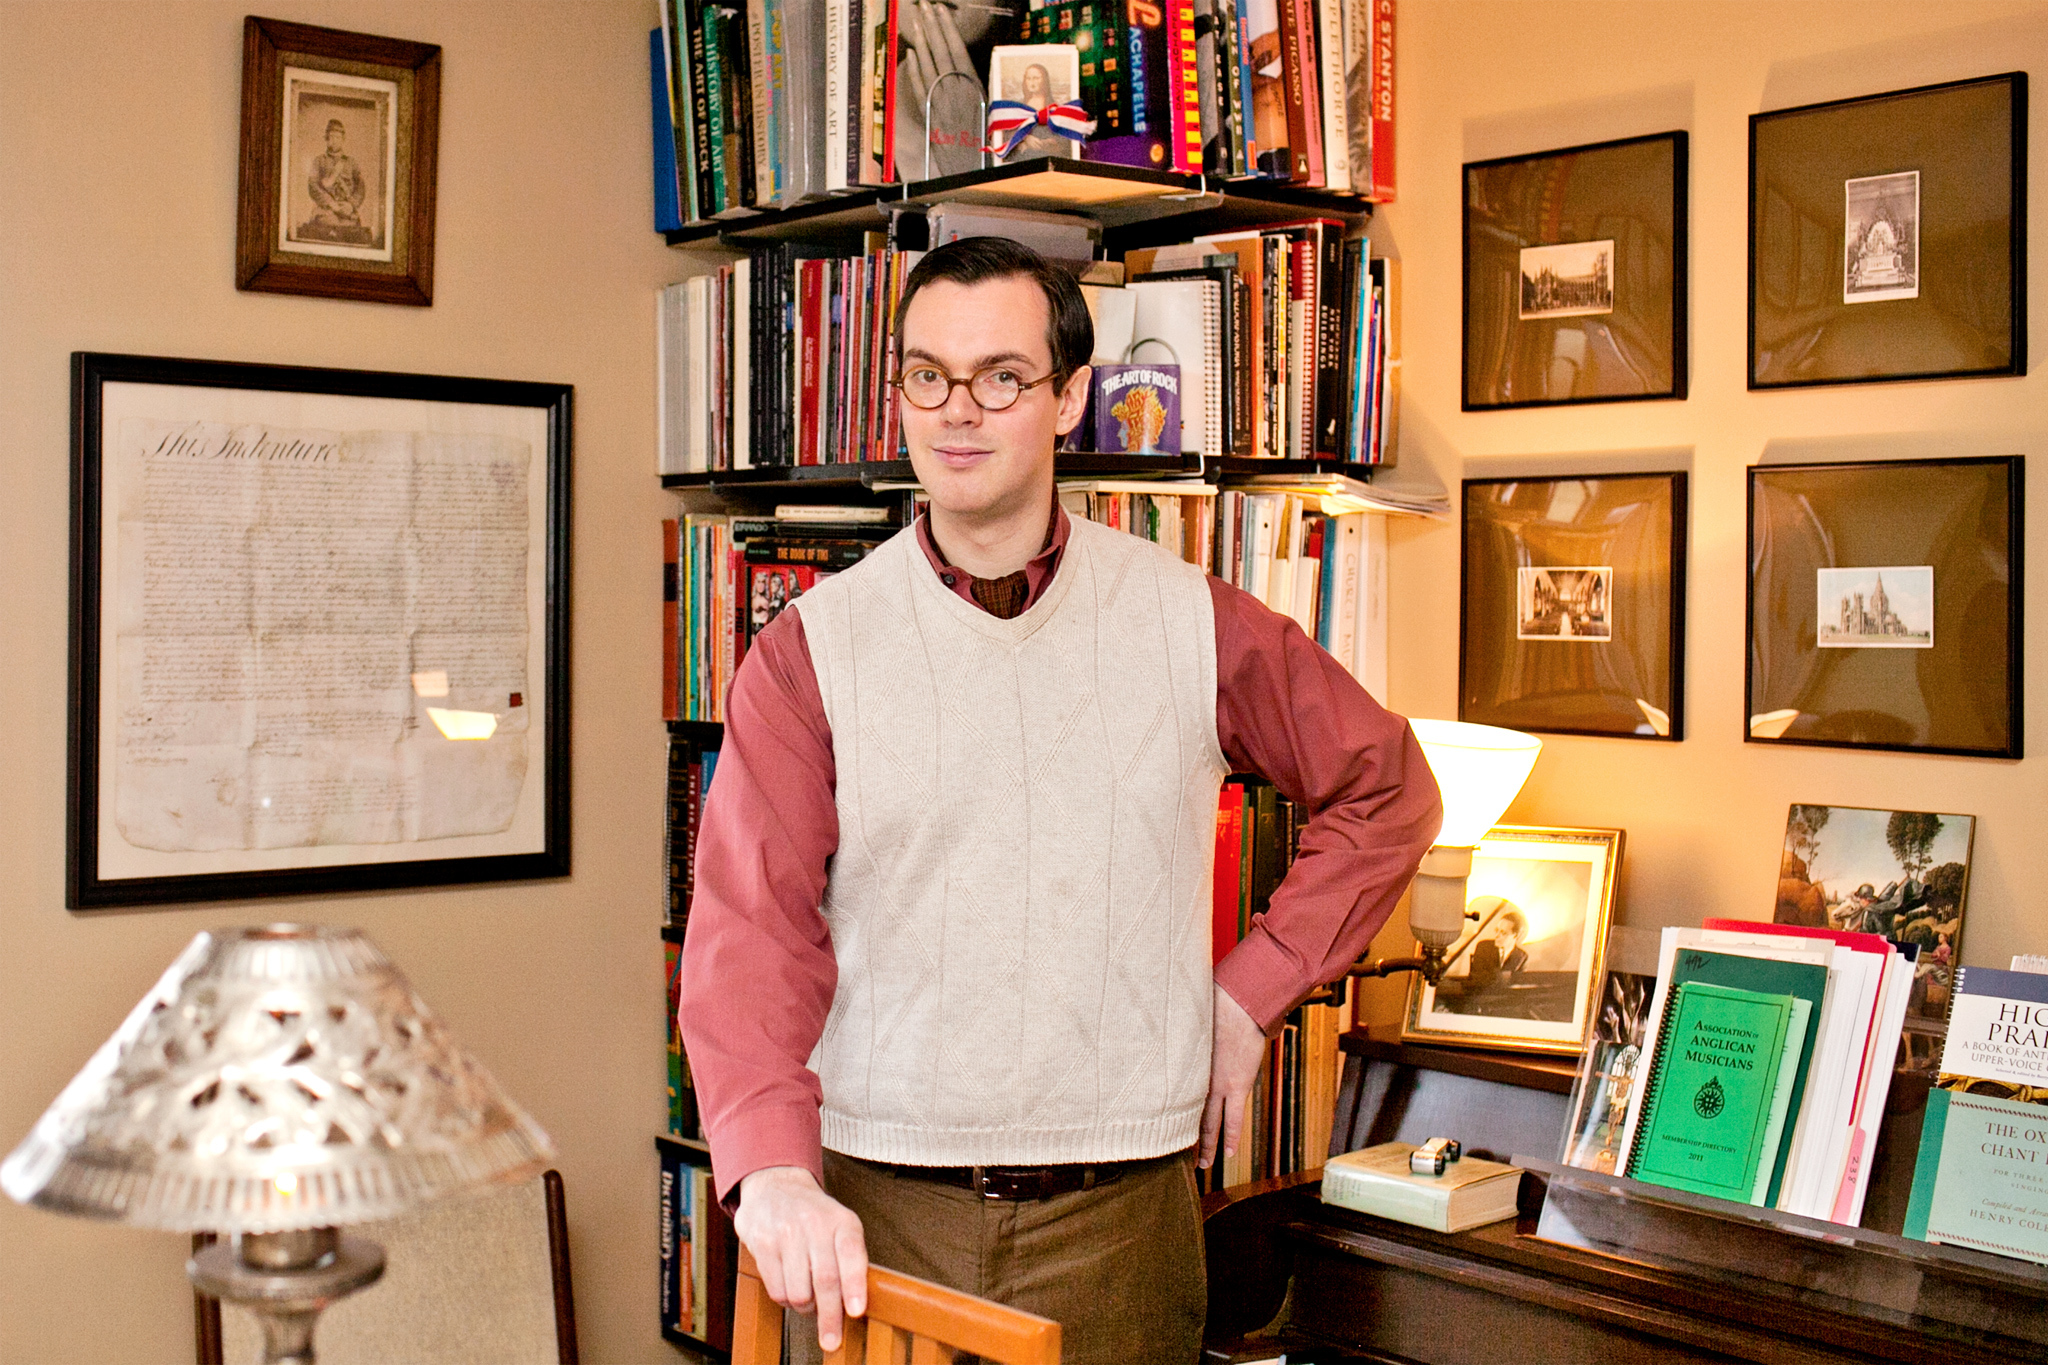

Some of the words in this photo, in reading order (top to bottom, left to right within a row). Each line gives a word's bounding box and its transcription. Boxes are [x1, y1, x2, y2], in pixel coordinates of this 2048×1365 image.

[771, 9, 784, 49] POP
[828, 6, 838, 74] HISTORY
[692, 26, 704, 61] THE
[752, 22, 766, 80] POSTER
[695, 62, 706, 94] ART
[705, 42, 720, 112] HISTORY
[773, 53, 783, 89] ART
[1216, 53, 1226, 106] EASE
[1288, 36, 1303, 107] PICASSO
[1328, 0, 1345, 139] PLETHORPE
[1380, 20, 1393, 123] STANTON
[829, 81, 838, 101] OF
[1175, 76, 1183, 111] DAVID
[697, 97, 708, 120] OF
[710, 116, 721, 138] OF
[755, 102, 768, 167] HISTORY
[828, 108, 838, 138] ART
[699, 123, 710, 174] ROCK
[712, 144, 723, 173] ART
[1328, 308, 1336, 333] NEW
[1319, 305, 1329, 370] BUILDINGS
[1328, 338, 1336, 369] YORK
[1101, 373, 1122, 396] THE
[1120, 369, 1140, 386] ART
[1139, 369, 1152, 384] OF
[1152, 370, 1178, 396] ROCK
[777, 547, 790, 561] THE
[790, 547, 806, 561] BOOK
[807, 548, 816, 561] OF
[1344, 552, 1358, 620] CHURCH
[689, 774, 697, 796] THE
[689, 803, 697, 824] BIG
[688, 831, 697, 883] PICTURE
[1693, 1019, 1752, 1039] ASSOCIATION
[1690, 1034, 1756, 1055] ANGLICAN
[1961, 1040, 1969, 1050] A
[1972, 1041, 2003, 1055] BOOK
[2005, 1046, 2021, 1057] OF
[2023, 1049, 2048, 1062] ANT
[1684, 1049, 1754, 1072] MUSICIANS
[1971, 1052, 2043, 1073] UPPER-VOICE
[1661, 1133, 1702, 1148] MEMBERSHIP
[1702, 1142, 1738, 1155] DIRECTORY
[1985, 1121, 2020, 1139] THE
[2024, 1128, 2048, 1145] OX
[1687, 1151, 1704, 1162] 2011
[1981, 1141, 2041, 1164] CHANT
[1993, 1167, 2010, 1177] FOR
[2013, 1171, 2044, 1184] THREE
[2011, 1182, 2048, 1196] SINGING
[1969, 1208, 2014, 1226] HENRY
[1981, 1197, 2013, 1210] Compiled
[2013, 1204, 2028, 1214] and
